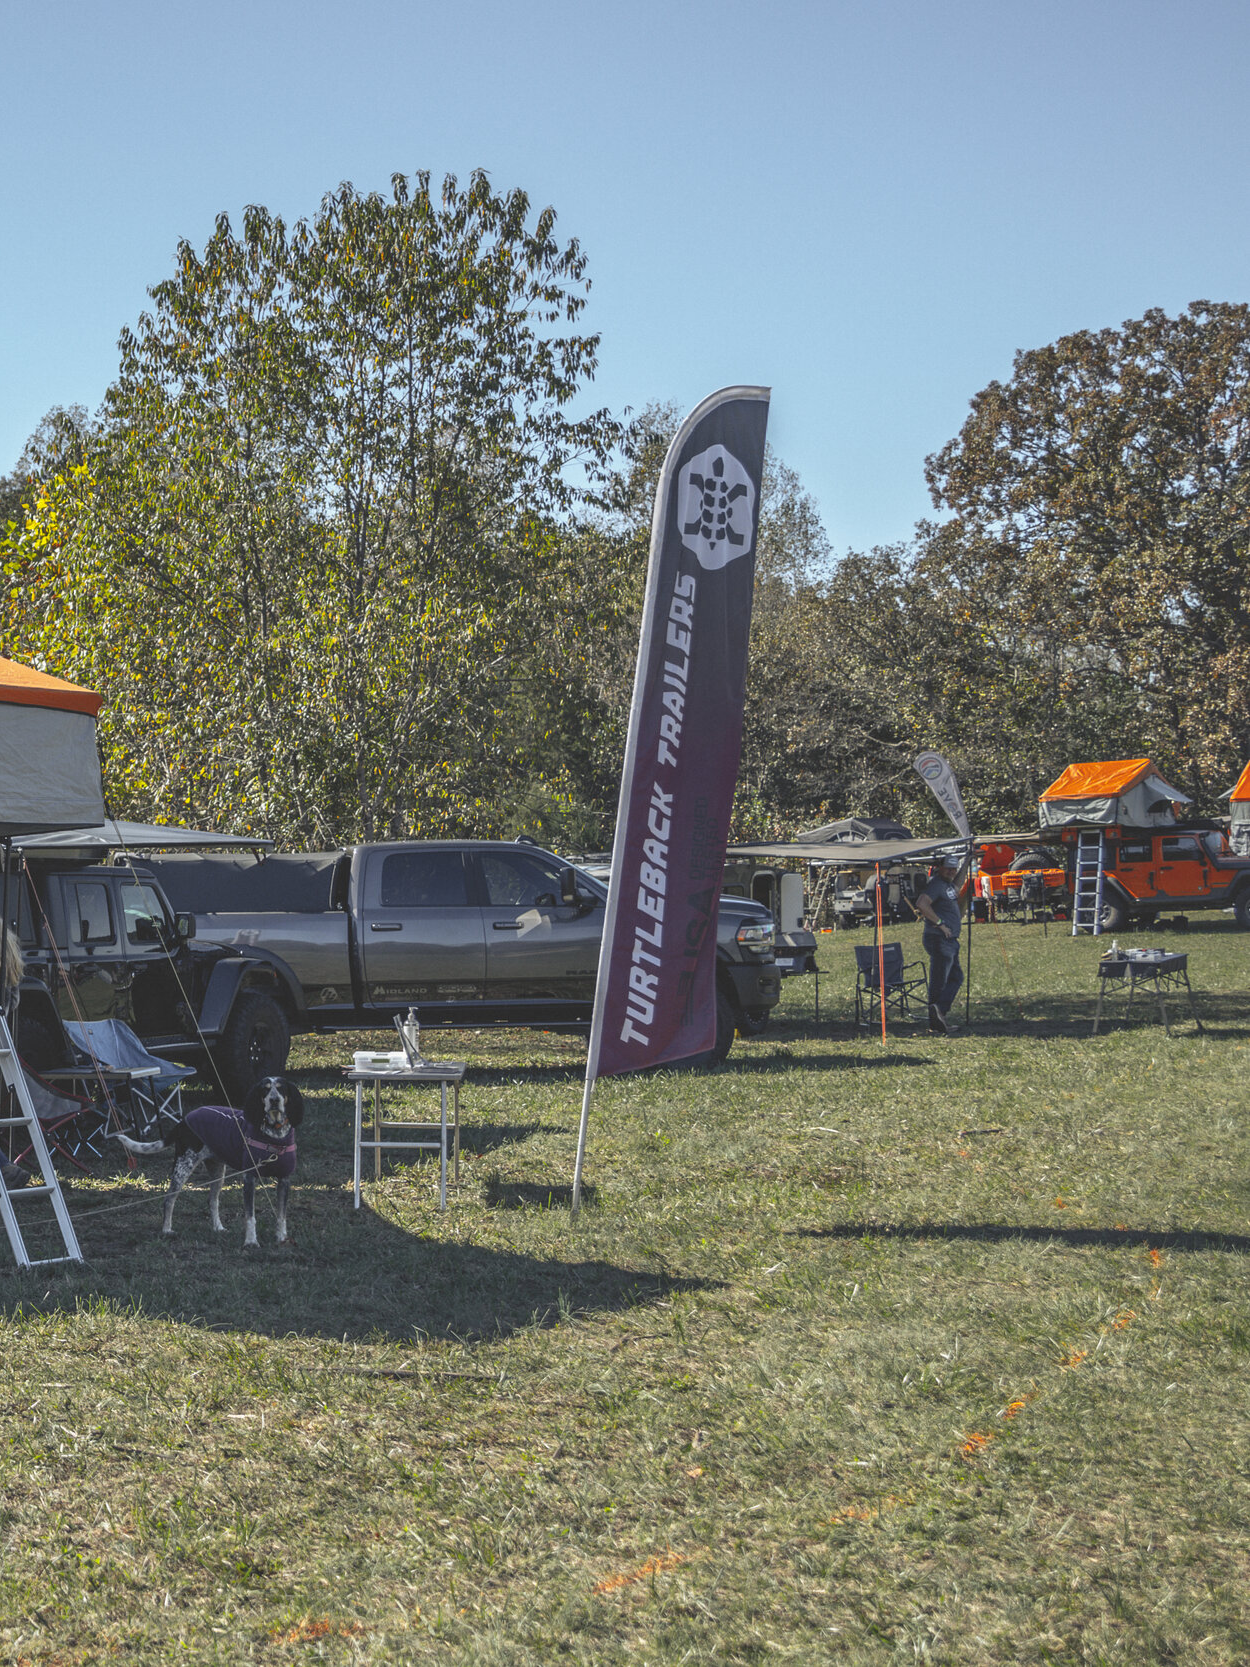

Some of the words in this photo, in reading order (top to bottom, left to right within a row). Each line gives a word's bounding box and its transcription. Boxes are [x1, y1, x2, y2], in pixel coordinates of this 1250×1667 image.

[620, 780, 673, 1047] TURTLEBACK
[657, 571, 696, 768] TRAILERS
[689, 796, 709, 881] DESIGNED
[373, 985, 427, 995] MIDLAND
